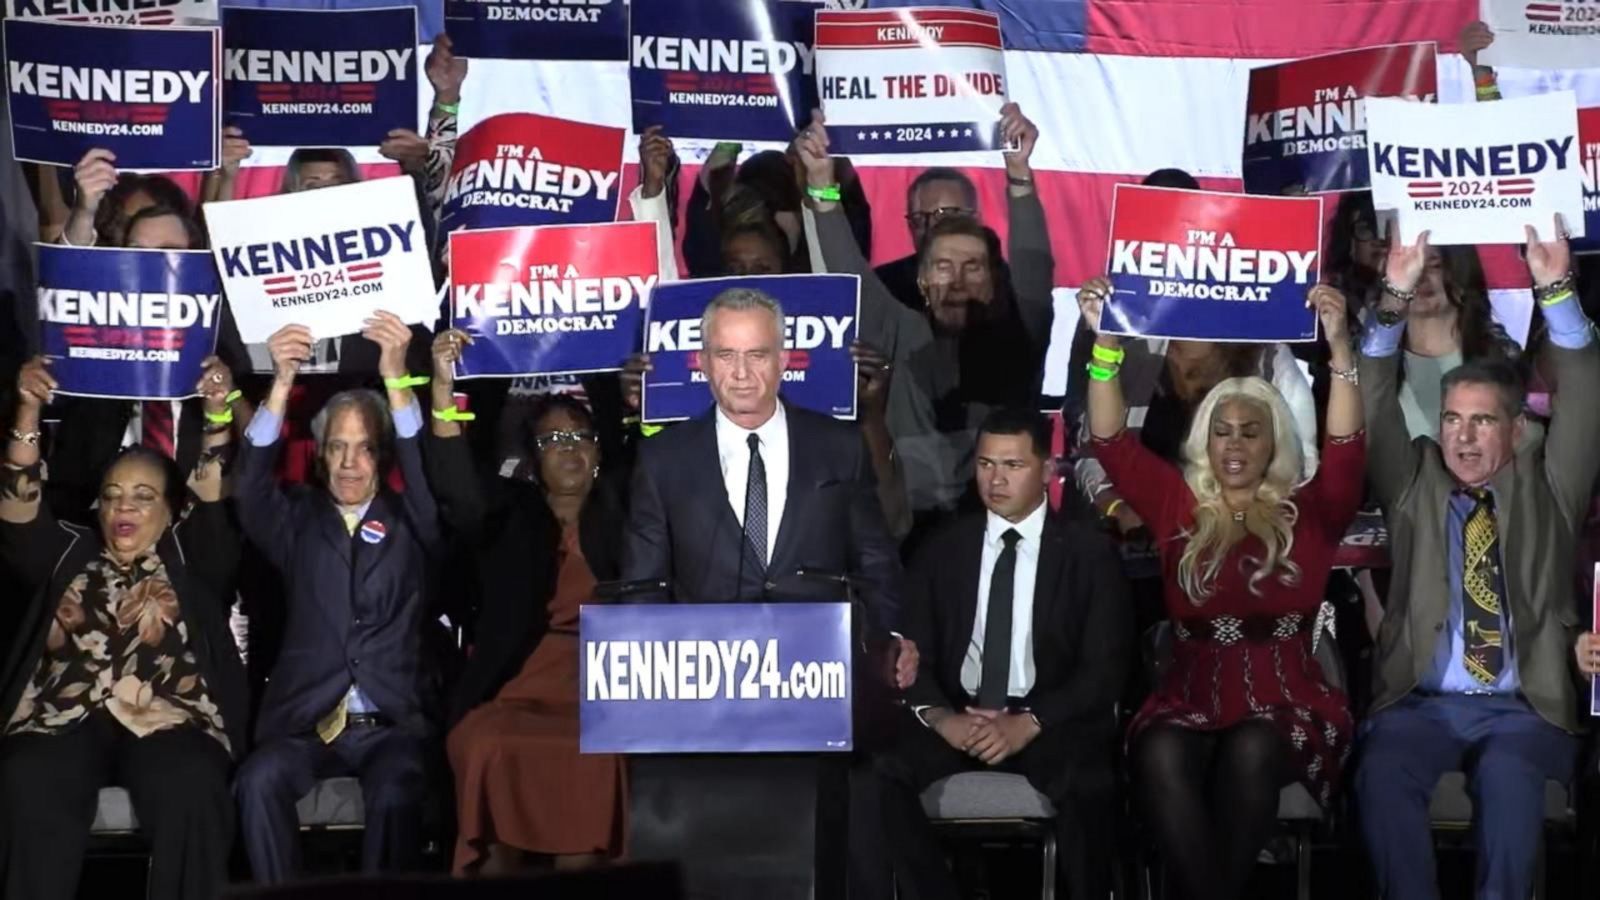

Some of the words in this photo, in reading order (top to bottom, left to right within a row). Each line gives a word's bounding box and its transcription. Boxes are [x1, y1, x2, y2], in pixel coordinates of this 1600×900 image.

[487, 6, 602, 23] DEMOCRAT
[1565, 6, 1600, 21] 202
[224, 48, 413, 83] KENNEDY
[9, 60, 211, 104] KENNEDY
[822, 76, 877, 100] HEAL
[883, 75, 928, 99] THE
[669, 92, 778, 107] KENNEDY24.COM
[1314, 87, 1340, 102] I'M
[1343, 85, 1358, 99] A
[262, 103, 373, 115] KENNEDY24.COM
[52, 119, 164, 136] KENNEDY24.COM
[897, 128, 932, 141] 2024
[496, 144, 525, 159] I'M
[528, 147, 544, 160] A
[1283, 134, 1367, 157] DEMOCR
[1373, 135, 1574, 178] KENNEDY
[444, 158, 618, 205] KENNEDY
[1448, 181, 1494, 196] 2024
[461, 191, 574, 213] DEMOCRAT
[1414, 197, 1532, 211] KENNEDY24.COM
[1187, 229, 1216, 246] I'M
[1220, 232, 1236, 247] A
[220, 220, 416, 278] KENNEDY
[529, 264, 559, 280] I'M
[563, 264, 580, 279] A
[1111, 239, 1317, 284] KENNEDY
[300, 269, 345, 290] 2024
[272, 282, 384, 308] KENNEDY24.COM
[455, 274, 658, 319] KENNEDY
[1148, 280, 1271, 302] DEMOCRAT
[37, 286, 220, 328] KENNEDY
[496, 314, 618, 335] DEMOCRAT
[586, 638, 846, 701] KENNEDY24.com
